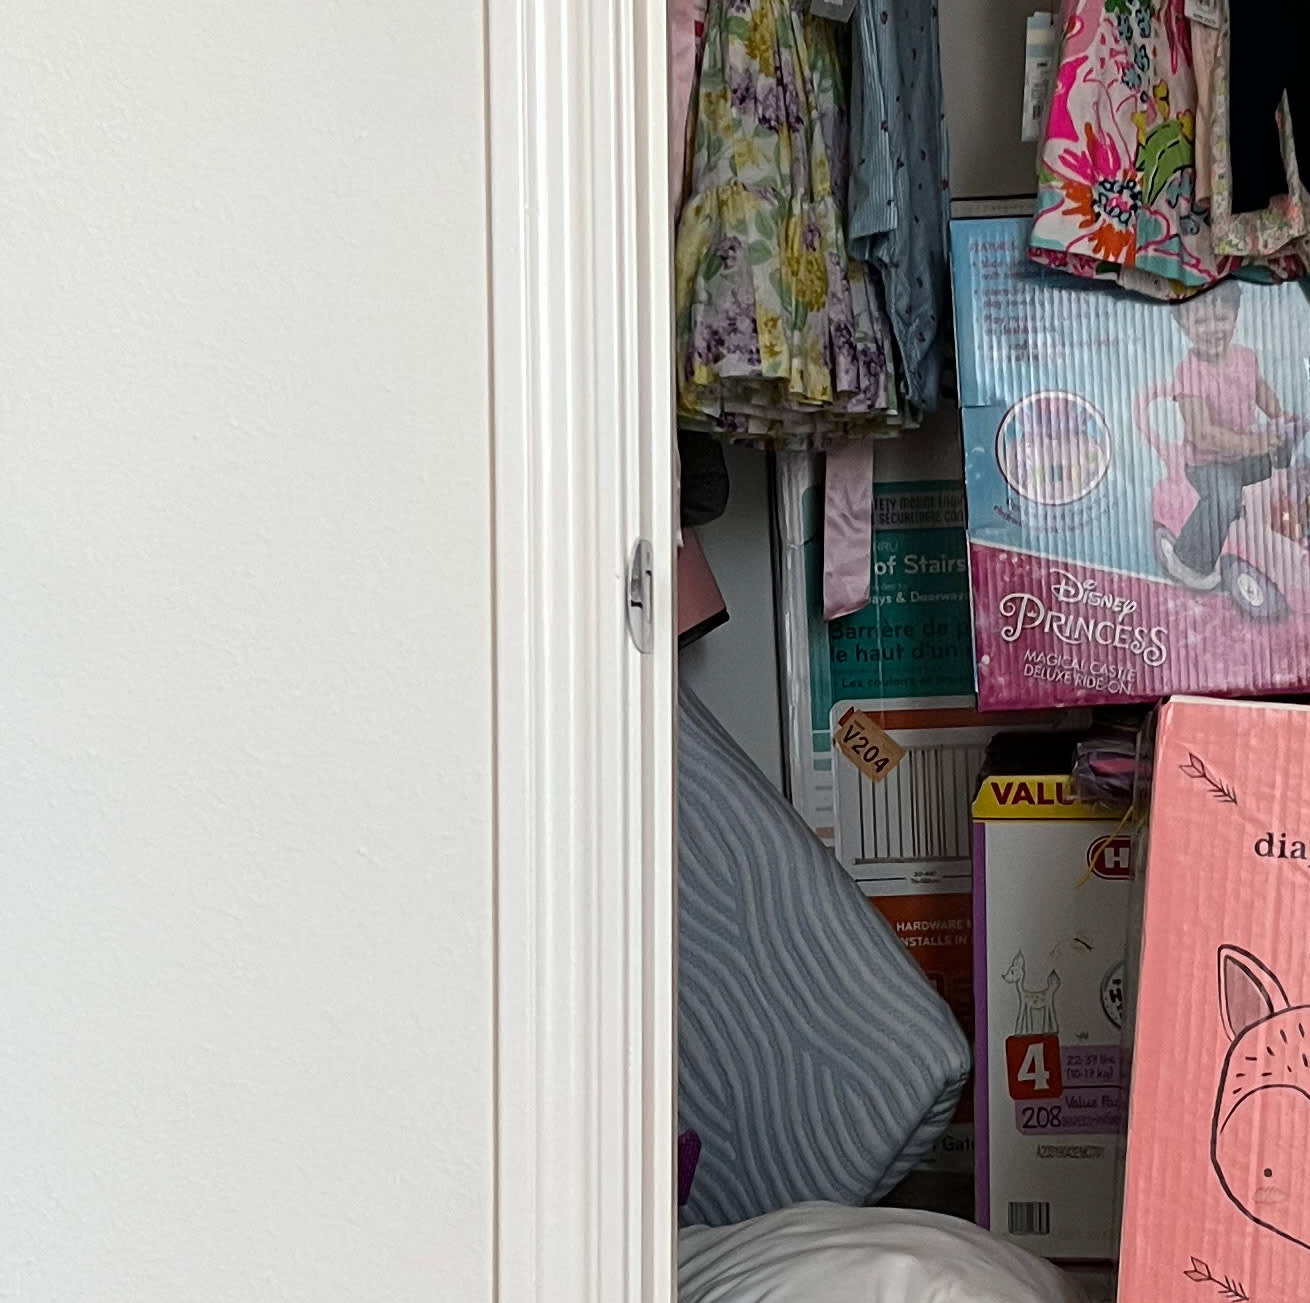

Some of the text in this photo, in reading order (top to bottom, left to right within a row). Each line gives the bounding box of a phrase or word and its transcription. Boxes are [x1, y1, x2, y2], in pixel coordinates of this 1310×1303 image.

[874, 553, 967, 576] of Stairs
[999, 592, 1168, 667] PRINCESS
[855, 641, 905, 664] haut
[1023, 648, 1137, 682] MAGICAL CASTLE
[1023, 663, 1072, 685] DELUXE
[842, 724, 891, 774] V204
[896, 918, 965, 933] HARDWARE
[902, 935, 952, 948] NSTALLS
[1016, 1042, 1051, 1091] 4
[1021, 1105, 1063, 1129] 208
